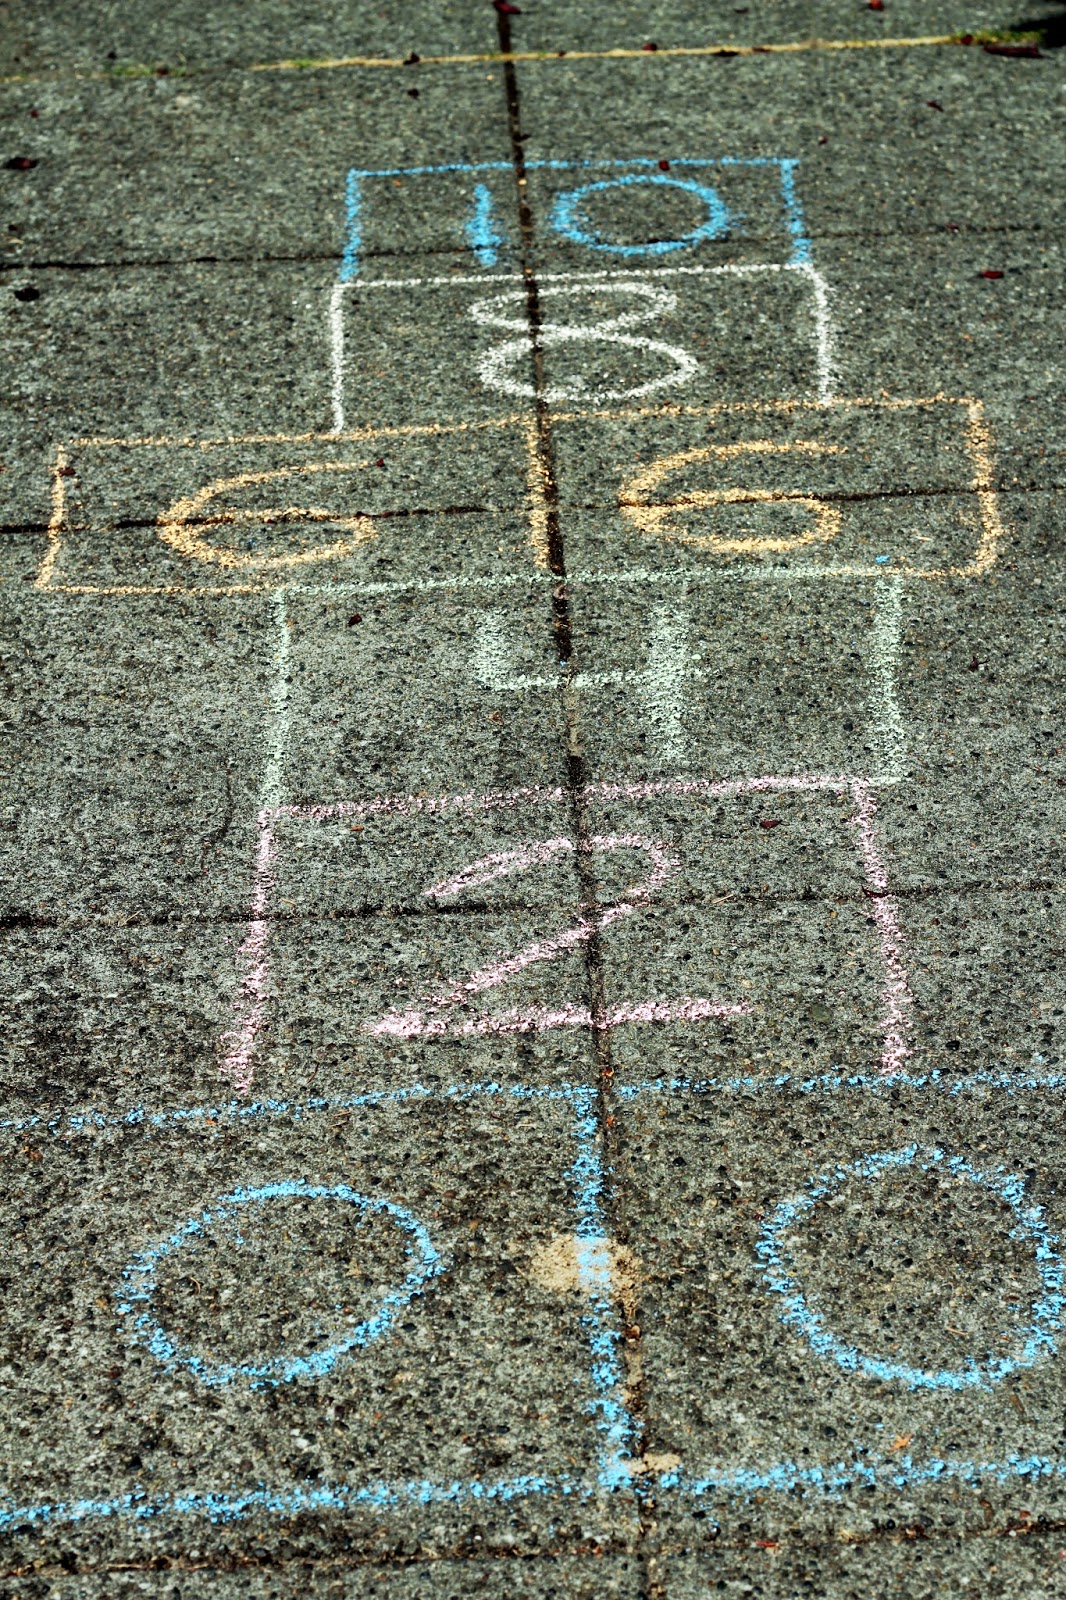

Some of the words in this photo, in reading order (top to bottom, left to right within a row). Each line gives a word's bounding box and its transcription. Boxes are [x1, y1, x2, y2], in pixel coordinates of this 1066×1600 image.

[465, 174, 730, 267] 10
[468, 283, 701, 403] 8
[156, 457, 379, 571] 6
[618, 438, 848, 555] 6
[471, 600, 706, 763] 4
[364, 833, 753, 1038] 2
